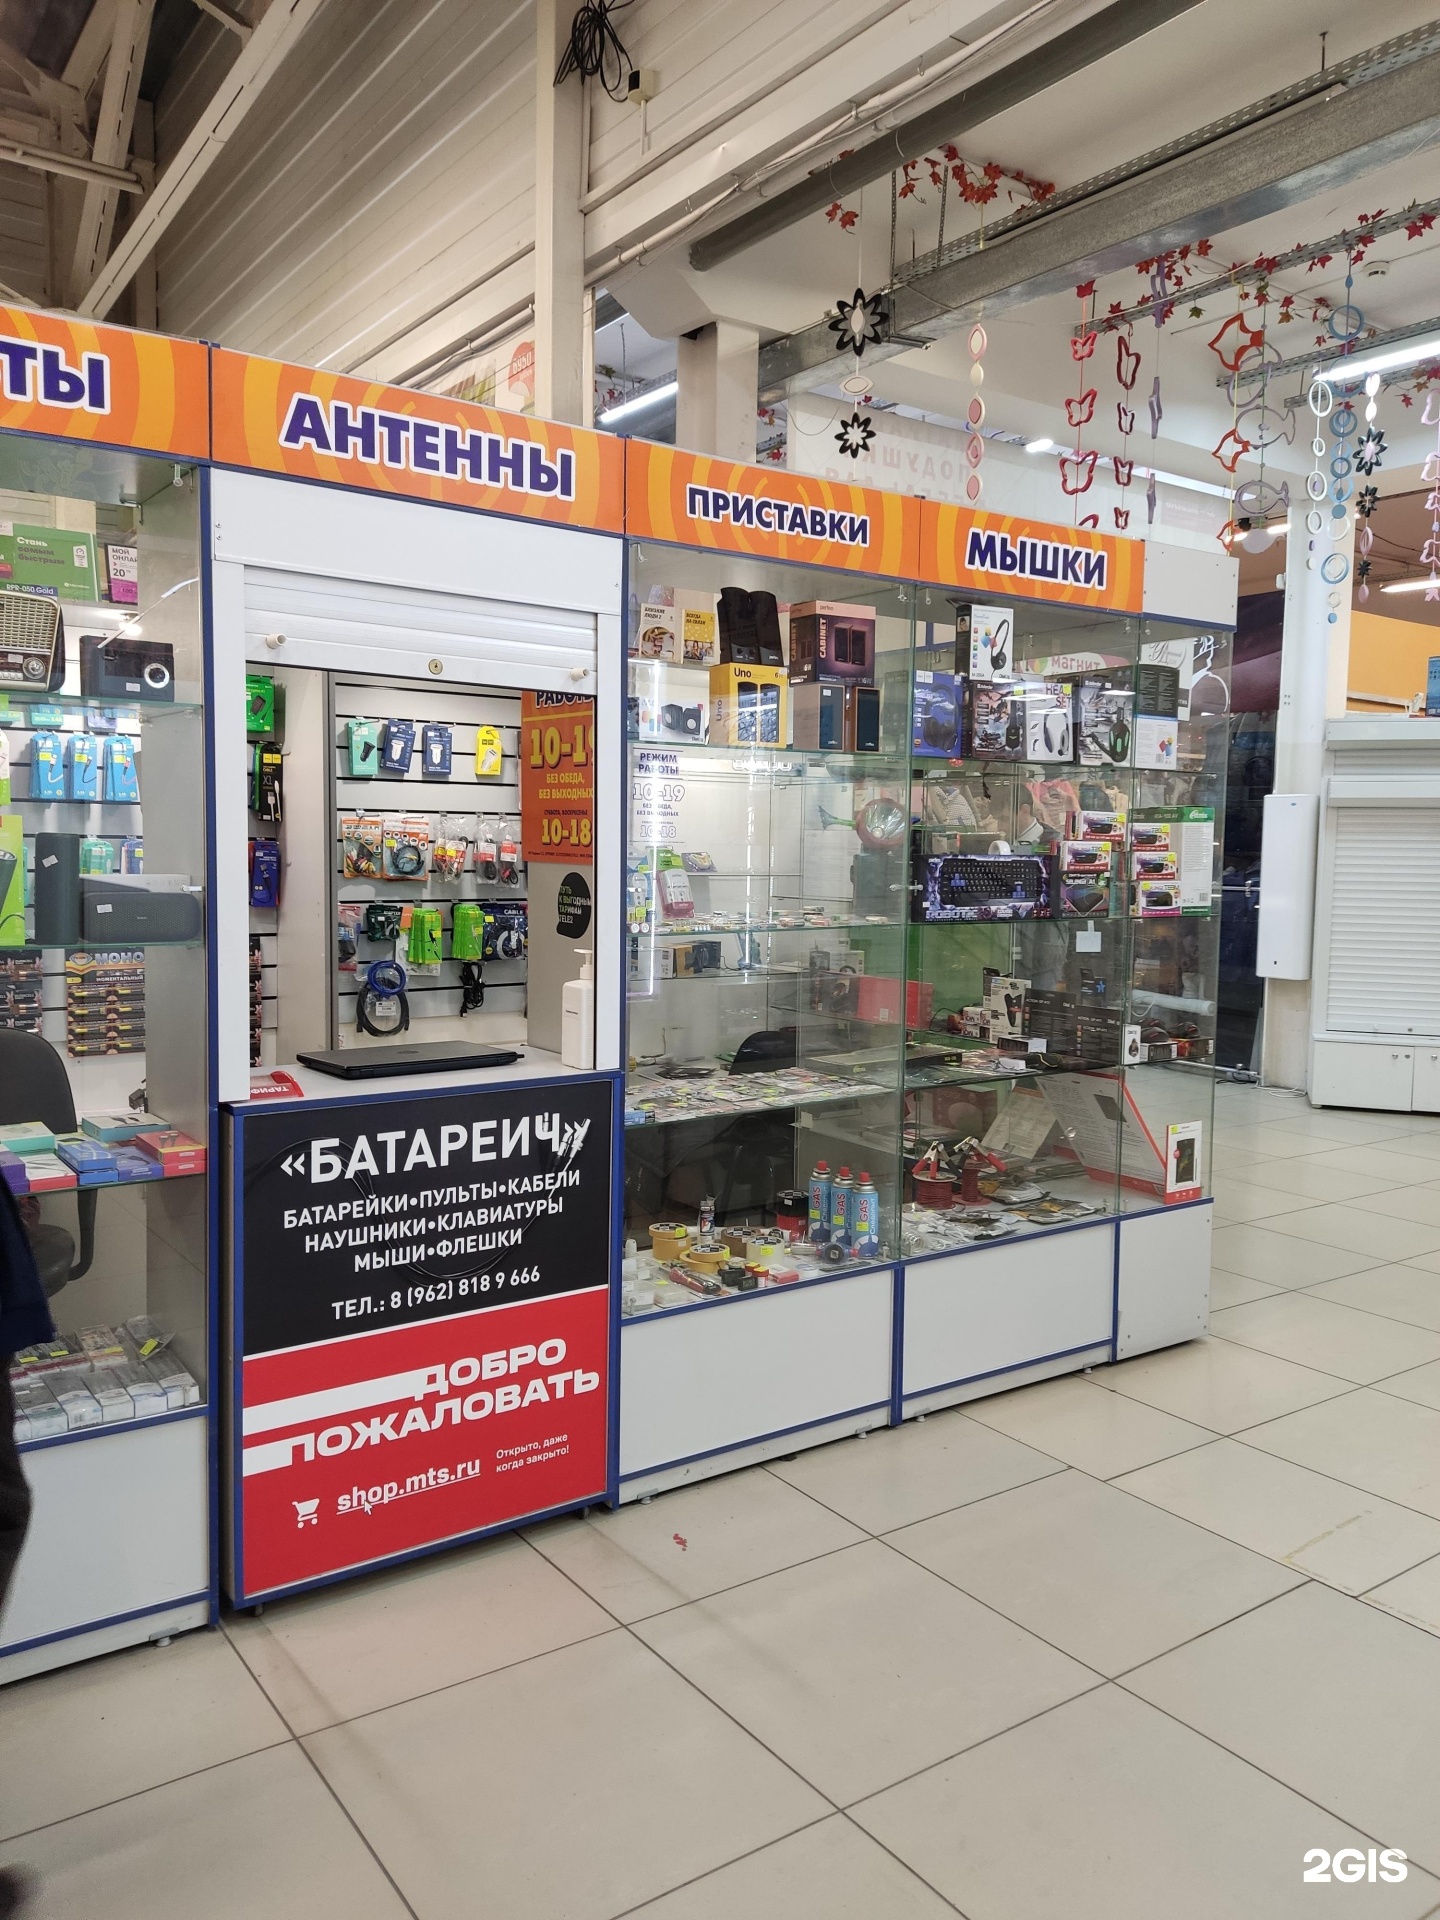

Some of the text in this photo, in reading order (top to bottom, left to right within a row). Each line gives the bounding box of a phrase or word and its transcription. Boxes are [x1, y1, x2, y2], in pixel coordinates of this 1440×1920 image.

[284, 396, 575, 497] АНТЕННЫ
[687, 486, 869, 545] ПРИСТАВКИ
[17, 537, 48, 547] Стань
[111, 548, 130, 556] МОЙ
[966, 531, 1106, 588] МЫШКИ
[113, 568, 126, 577] 20
[6, 584, 54, 595] RPR-050 Gold
[819, 617, 827, 659] CABINET
[734, 667, 752, 678] Uno
[1056, 697, 1072, 708] SET
[640, 752, 677, 763] РЕЖИМ
[546, 772, 585, 785] БЕЗ ОБЕДА,
[539, 788, 551, 799] БЕЗ
[541, 818, 592, 847] 10-18
[559, 886, 572, 894] ПУТЬ
[559, 895, 563, 903] К
[559, 905, 582, 915] ТАРИФАМ
[559, 915, 574, 924] TELE2
[95, 951, 145, 965] МОНО
[812, 1186, 821, 1209] GAS
[837, 1193, 846, 1216] GAS
[859, 1199, 869, 1222] GAS
[332, 1265, 541, 1320] ТЕЛ.: 8 (962) 818 9 666
[413, 1338, 567, 1401] ДОБРО
[284, 1368, 600, 1465] ПОЖАЛОВАТЬ
[496, 1434, 568, 1459] Открыто, даже
[496, 1445, 569, 1473] когда закрыто!
[337, 1458, 481, 1511] shop.mts.ru
